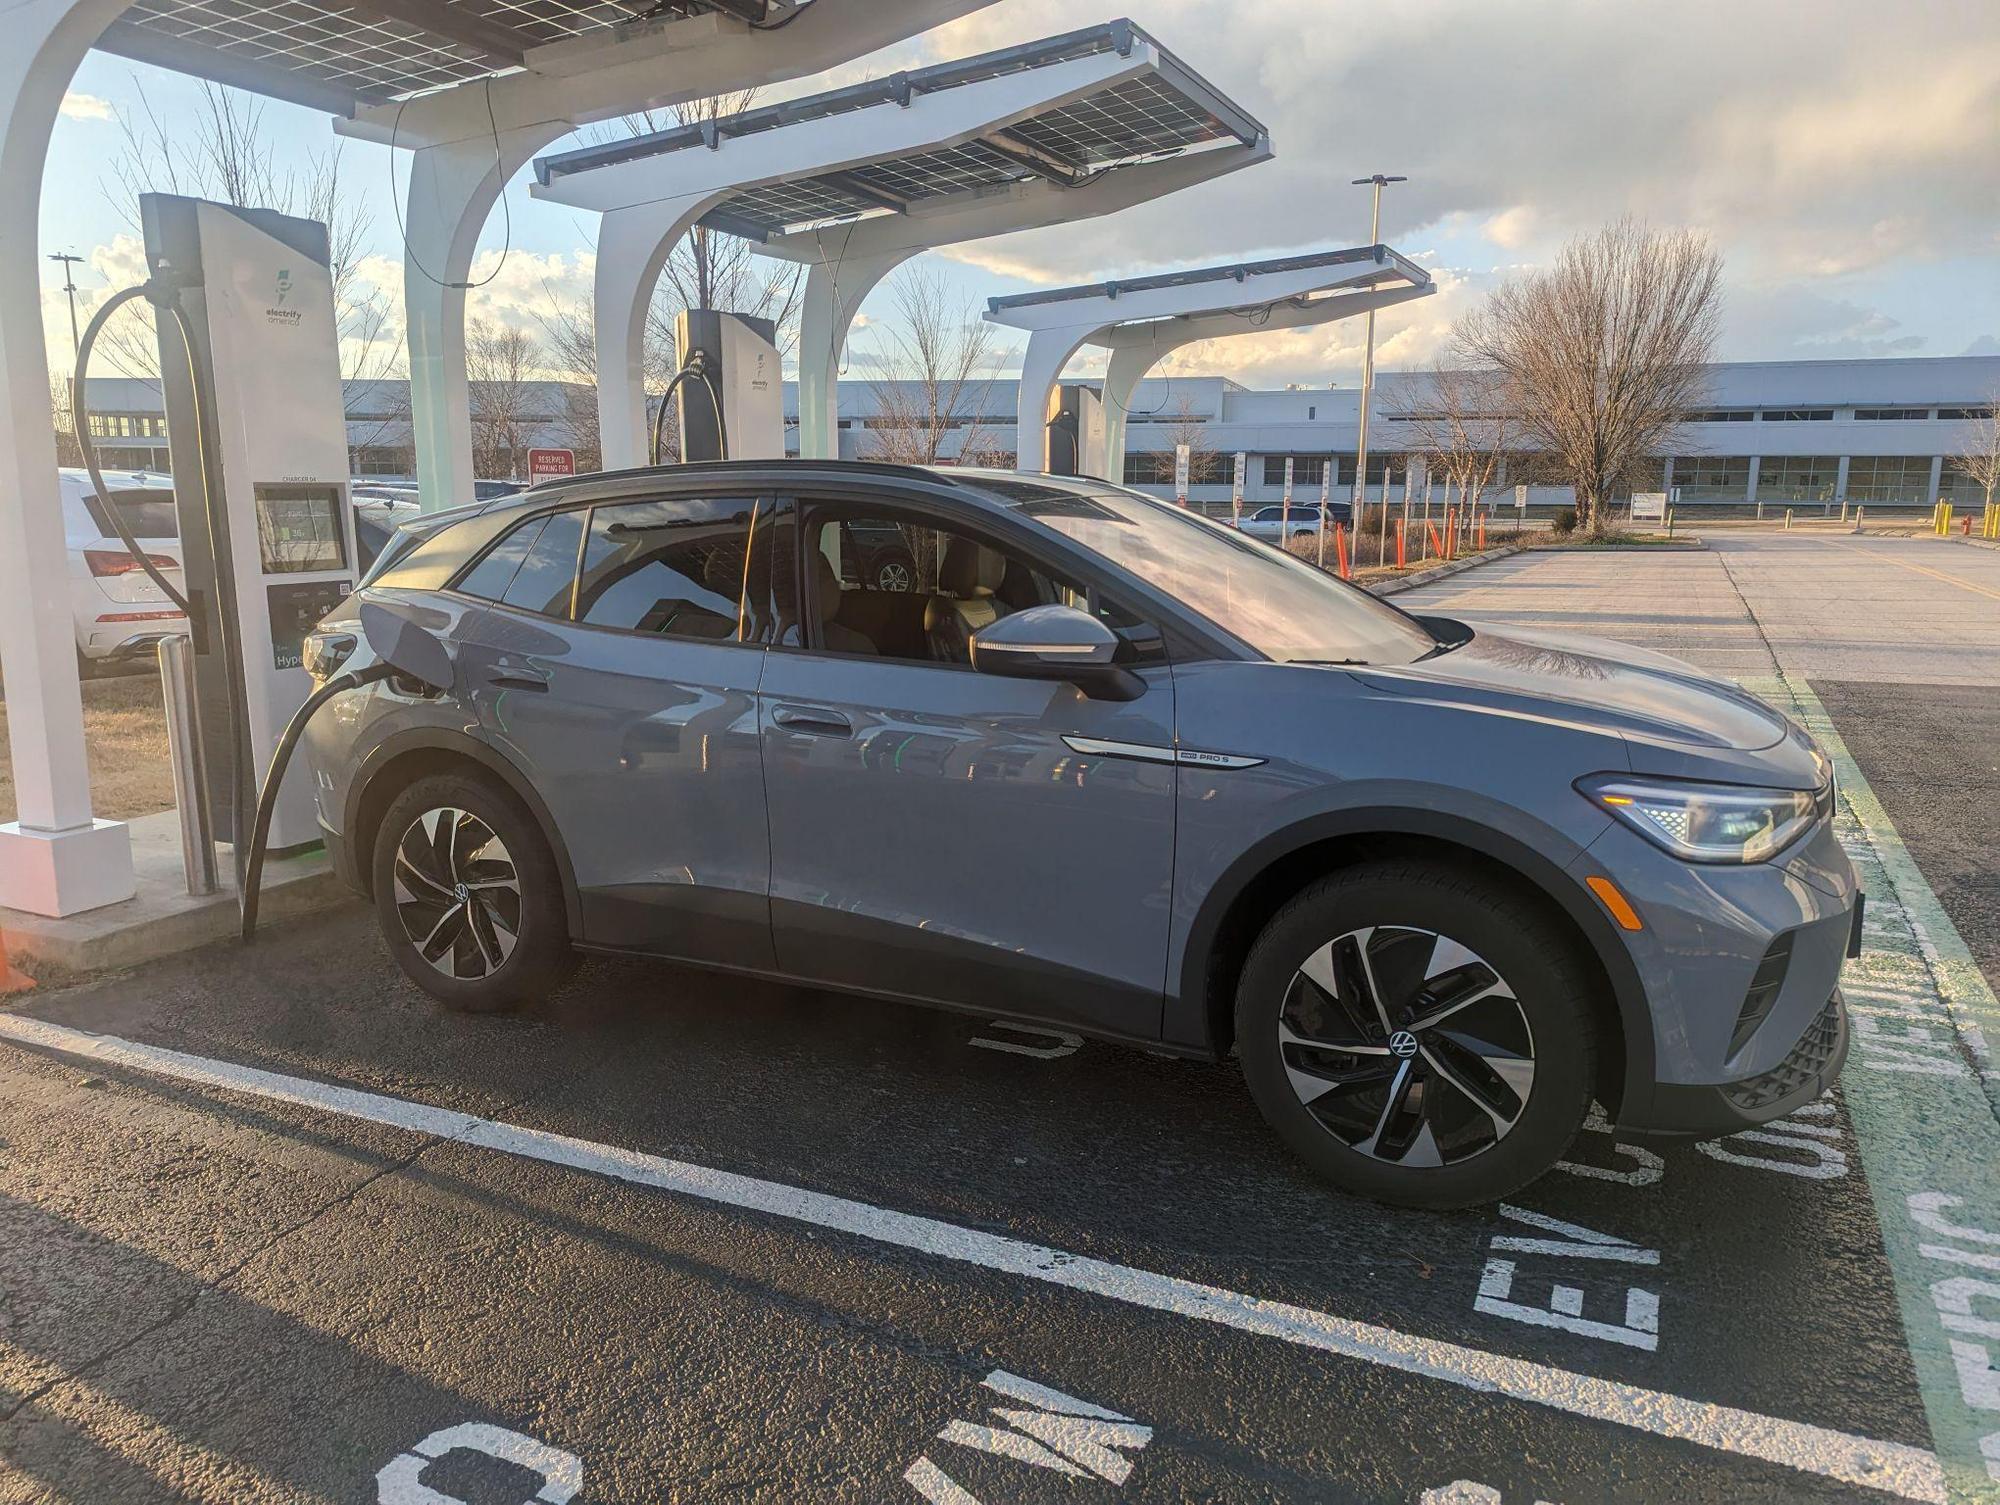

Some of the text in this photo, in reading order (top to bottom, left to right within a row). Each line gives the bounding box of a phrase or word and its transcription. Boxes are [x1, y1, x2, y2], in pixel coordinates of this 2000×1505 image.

[266, 308, 302, 319] electrify
[267, 317, 300, 326] america
[538, 455, 565, 464] RESERVED
[535, 464, 569, 473] PARKING FOR
[1199, 754, 1221, 762] PRO
[1472, 1201, 1662, 1352] EV
